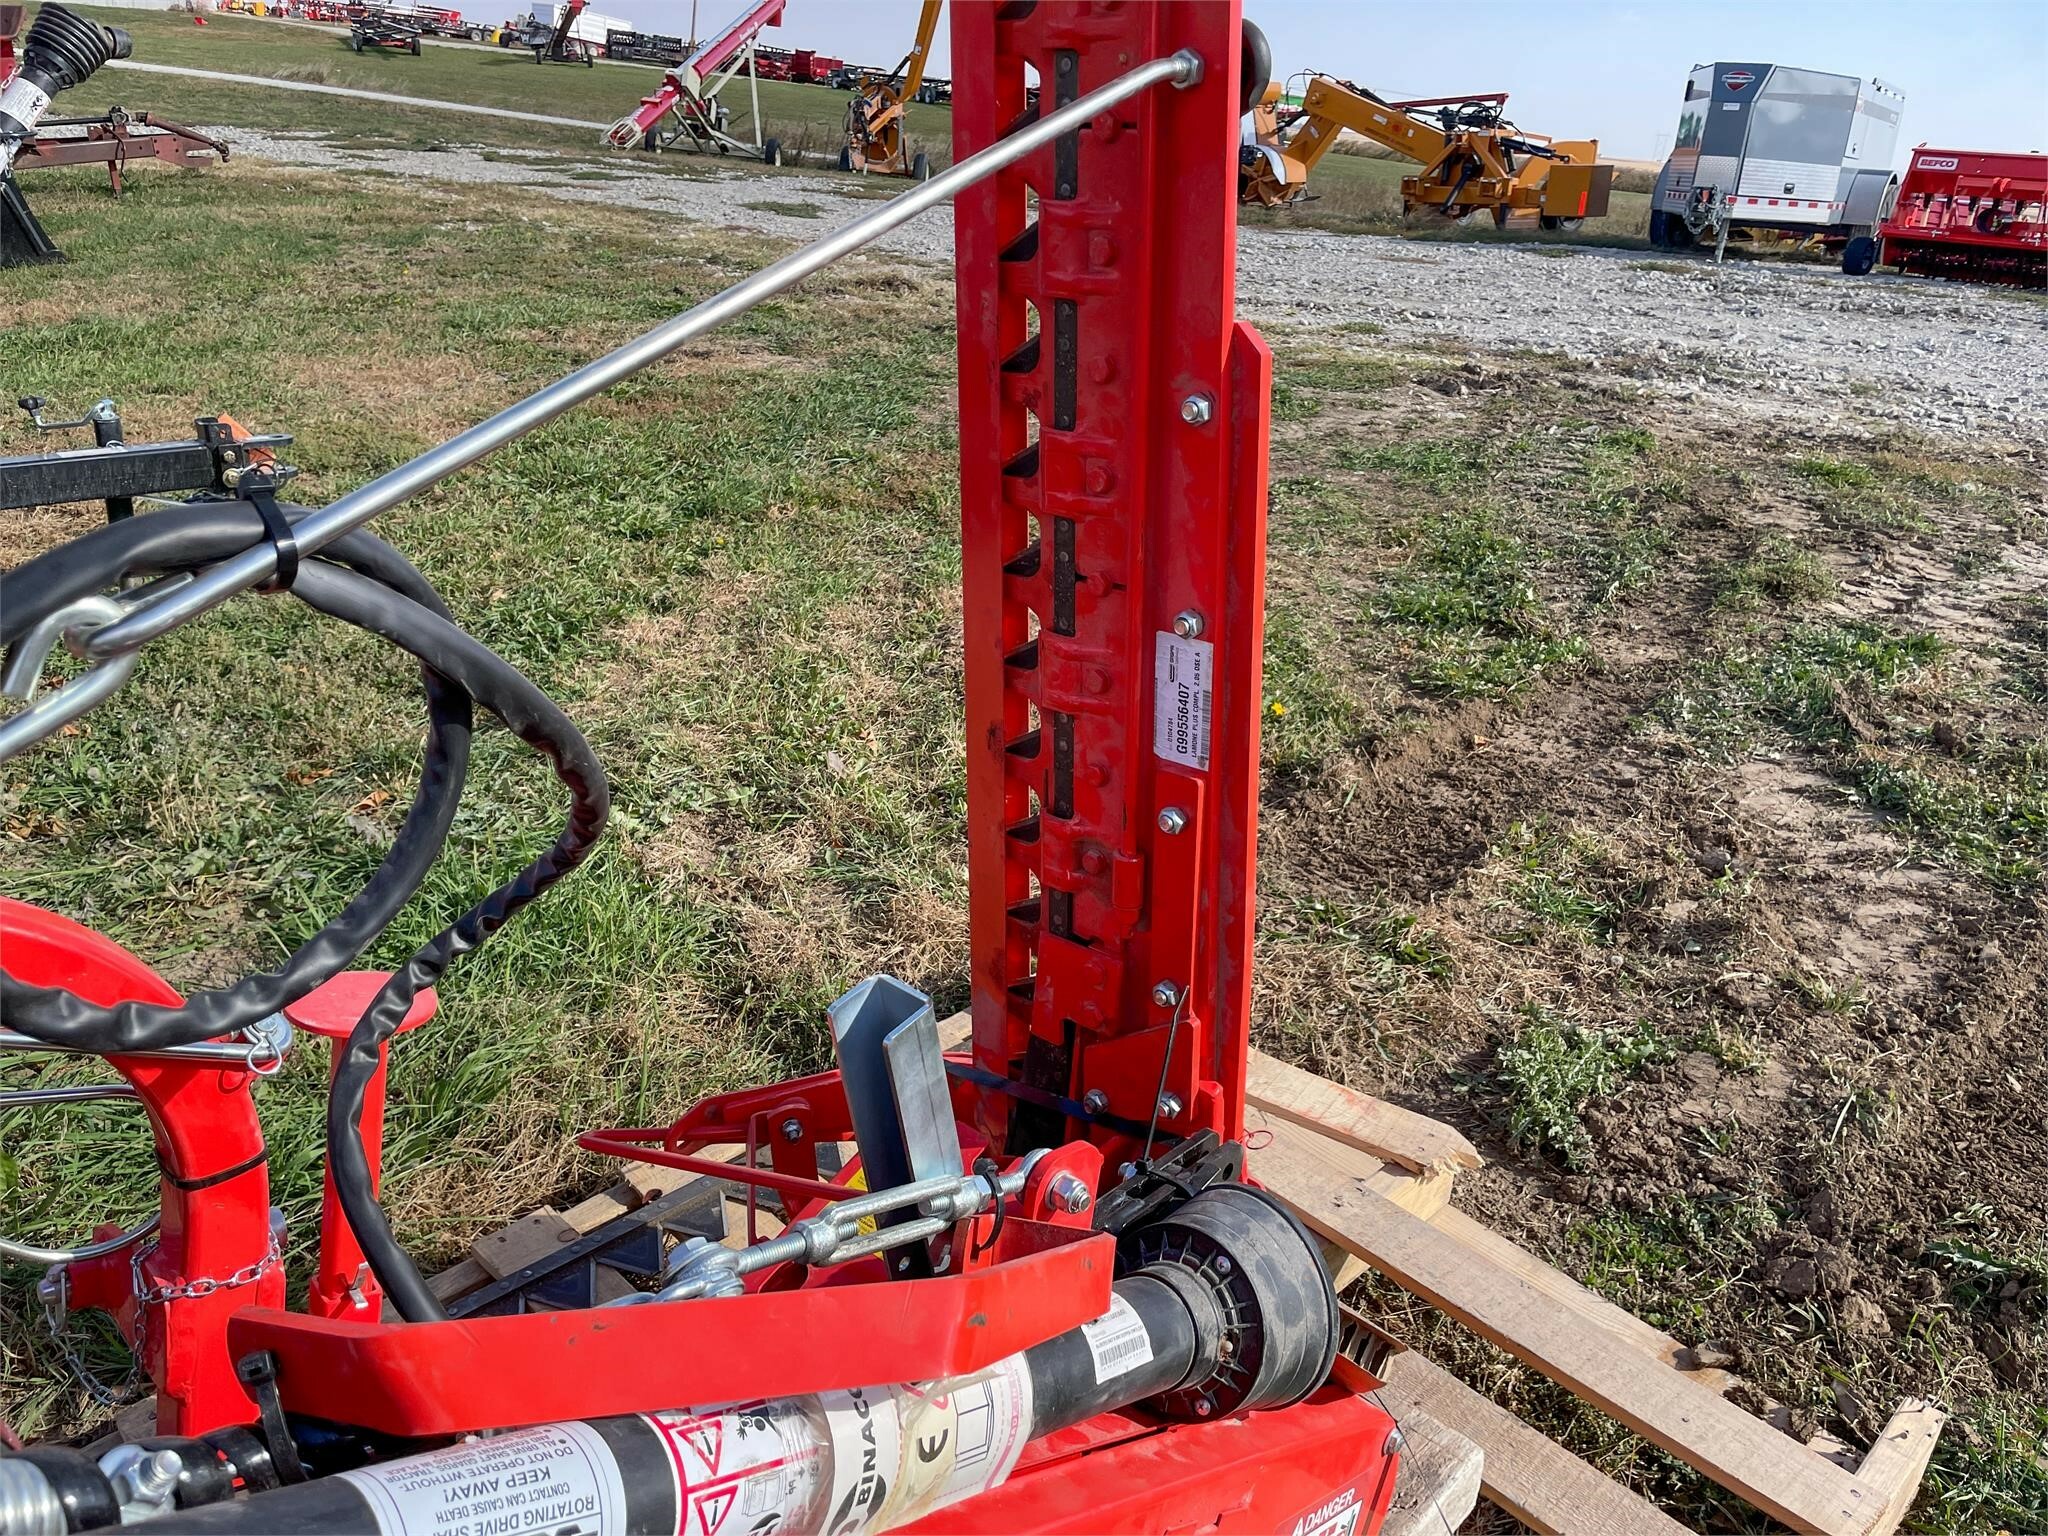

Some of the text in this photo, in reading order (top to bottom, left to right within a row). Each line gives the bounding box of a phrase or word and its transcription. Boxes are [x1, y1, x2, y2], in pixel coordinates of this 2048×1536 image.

[1920, 158, 1955, 168] BEFCO
[1177, 682, 1190, 755] G99556407
[477, 1440, 530, 1455] EQUIPMENT
[511, 1444, 539, 1455] DRIVE
[539, 1440, 556, 1448] ALL
[554, 1446, 574, 1457] DO
[479, 1450, 510, 1462] SHAFT
[528, 1450, 553, 1464] NOT
[384, 1467, 433, 1483] TRACTOR
[465, 1457, 525, 1477] OPERATE
[443, 1466, 551, 1503] KEEP AWAY!
[436, 1481, 570, 1524] CONTACT CAN CAUSE DEATH
[524, 1494, 594, 1525] ROTATING
[1304, 1487, 1355, 1533] DANGER
[474, 1513, 519, 1536] DRIVE
